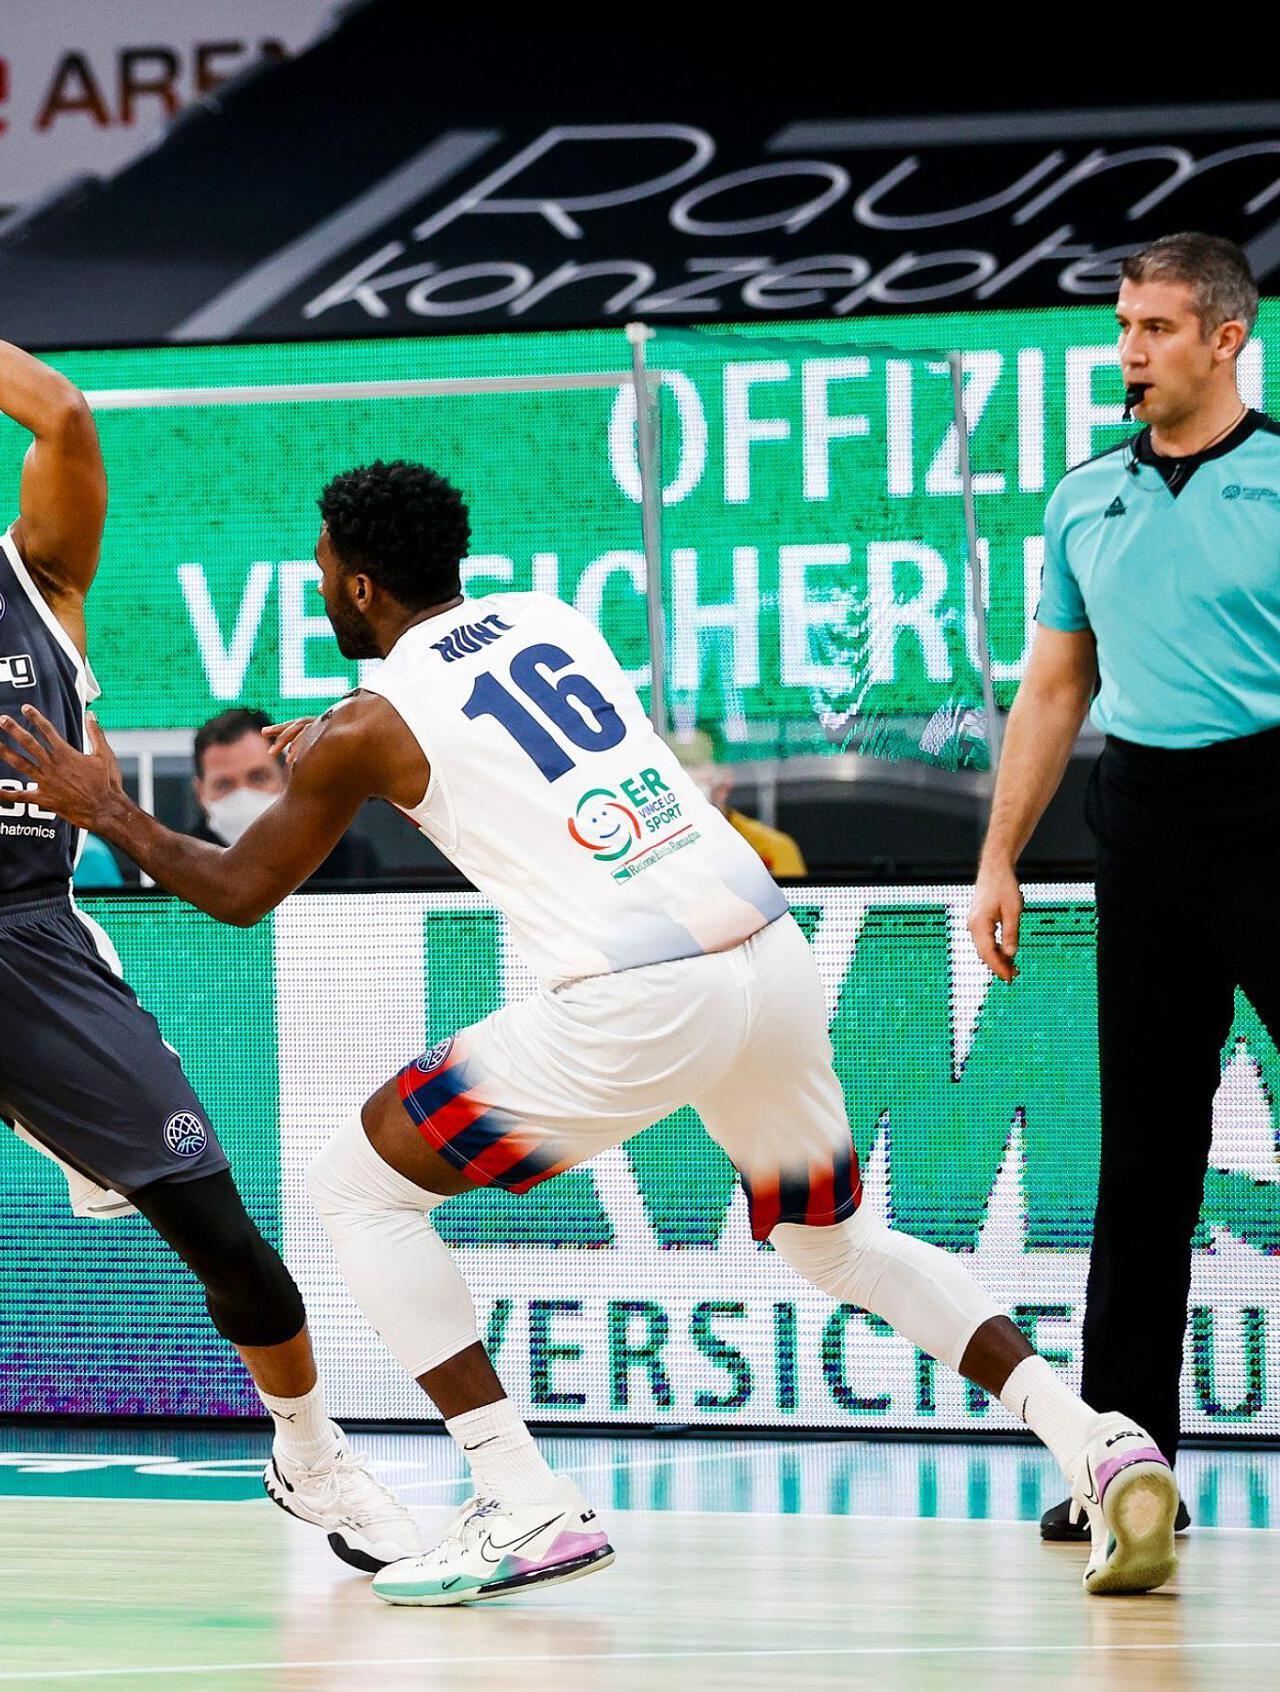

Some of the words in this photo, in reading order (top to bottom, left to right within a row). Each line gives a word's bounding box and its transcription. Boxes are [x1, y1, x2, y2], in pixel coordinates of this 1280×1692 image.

[36, 38, 288, 131] ARE
[412, 122, 1280, 241] Raum
[428, 614, 516, 663] HUNT
[461, 643, 627, 783] 16
[645, 803, 683, 833] SPORT
[663, 792, 676, 806] LO
